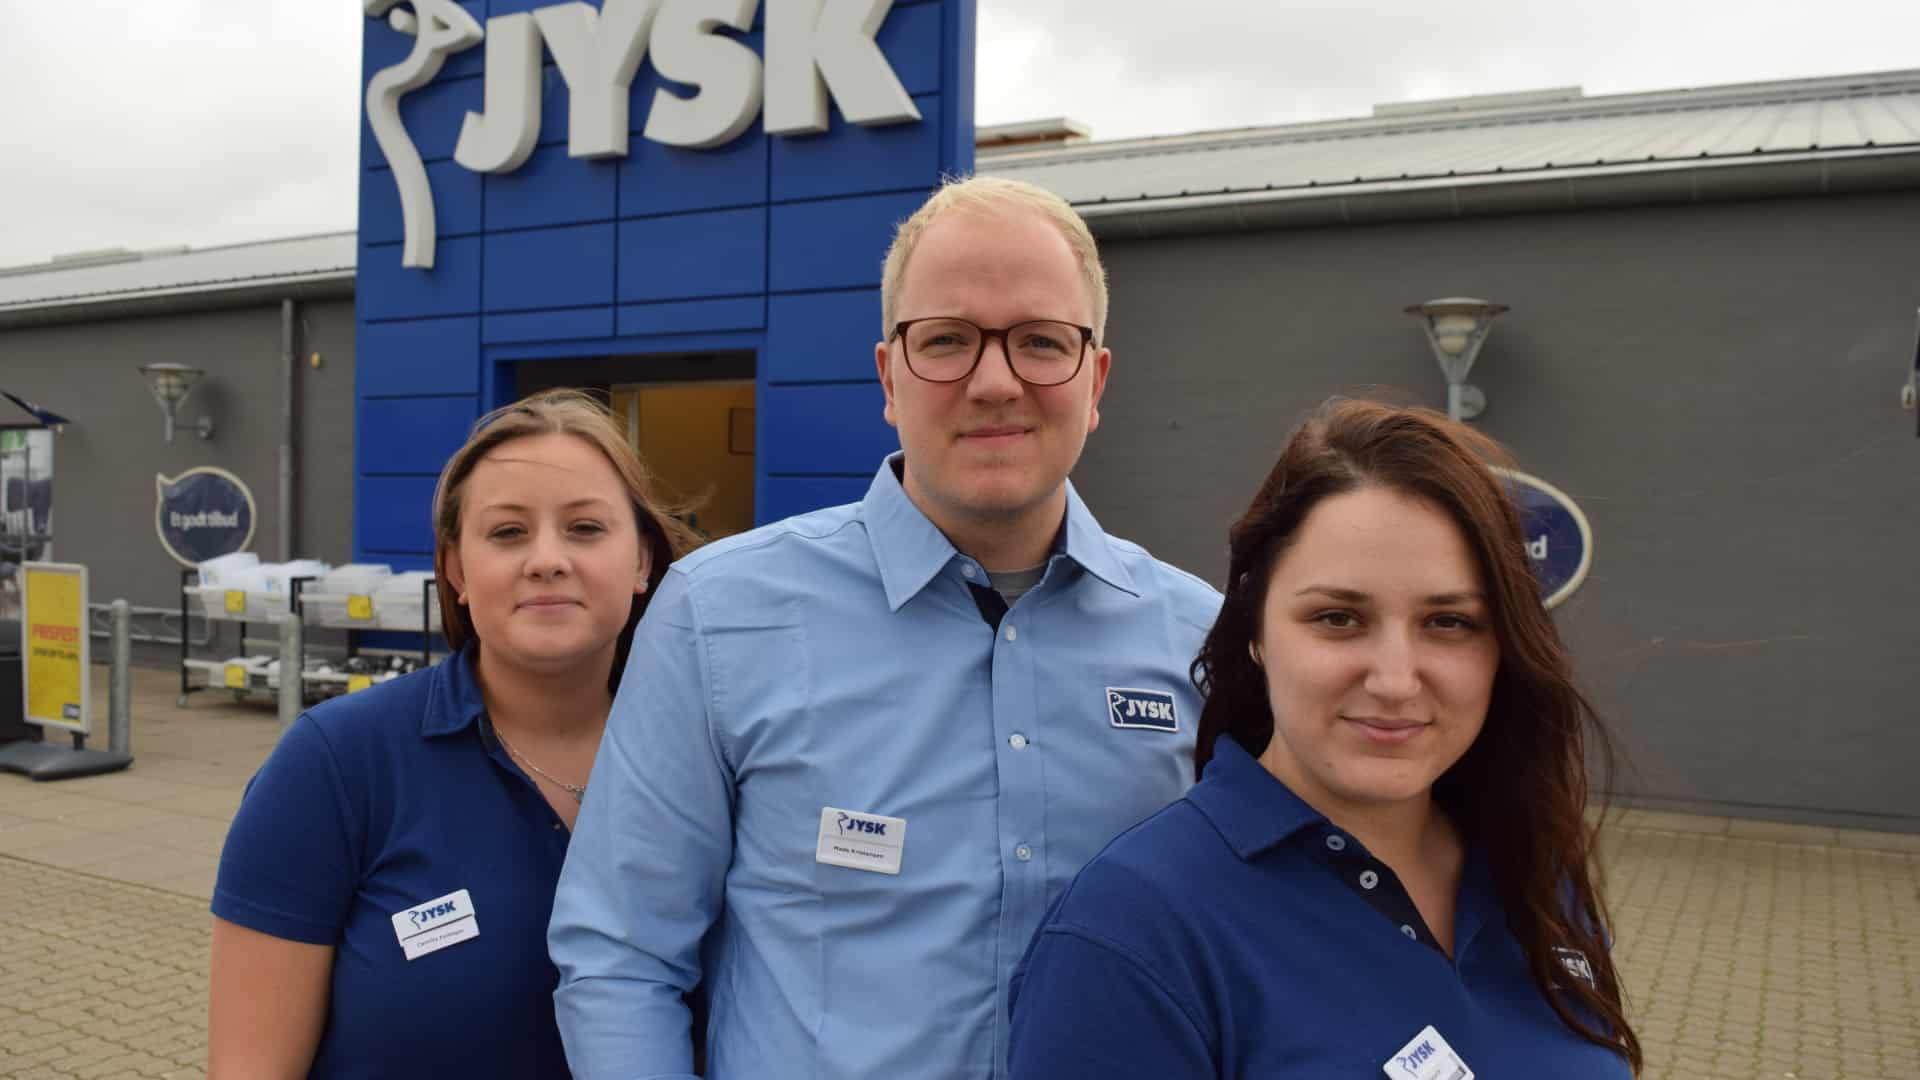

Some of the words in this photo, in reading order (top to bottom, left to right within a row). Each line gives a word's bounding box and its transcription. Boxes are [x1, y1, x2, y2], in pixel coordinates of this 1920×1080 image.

[454, 0, 922, 174] JYSK
[1126, 700, 1173, 720] JYSK
[846, 819, 886, 835] JYSK
[420, 900, 456, 922] JYSK
[1408, 1040, 1436, 1069] JYSK
